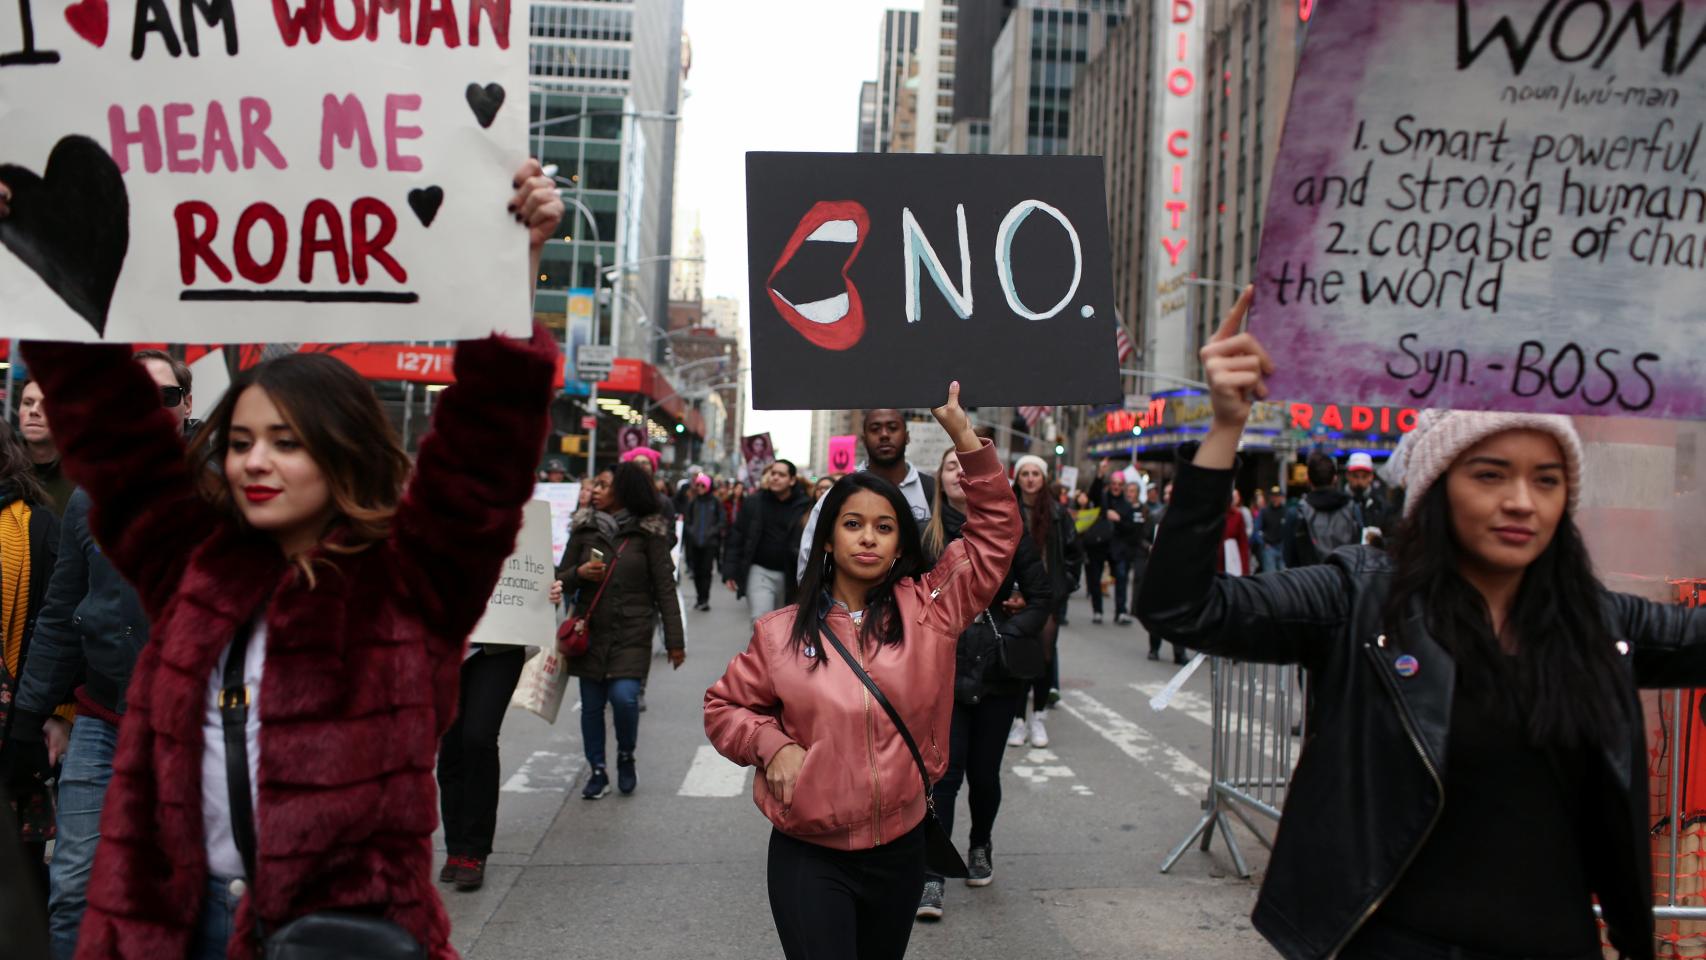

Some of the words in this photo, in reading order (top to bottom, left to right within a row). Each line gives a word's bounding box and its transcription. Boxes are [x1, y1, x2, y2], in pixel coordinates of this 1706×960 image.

[0, 0, 60, 66] I
[131, 0, 239, 60] AM
[271, 0, 511, 50] WOMAN
[108, 97, 287, 173] HEAR
[320, 92, 423, 172] ME
[1380, 115, 1515, 172] Smart,
[1161, 129, 1190, 267] CITY
[1294, 159, 1374, 207] and
[1386, 160, 1541, 222] strong
[1559, 168, 1706, 223] human
[174, 197, 407, 285] ROAR
[902, 199, 1095, 322] NO.
[1571, 217, 1626, 263] of
[1271, 261, 1344, 307] the
[1360, 259, 1504, 313] world
[397, 351, 442, 376] 1271
[1290, 402, 1418, 433] RADIO
[524, 552, 545, 575] the
